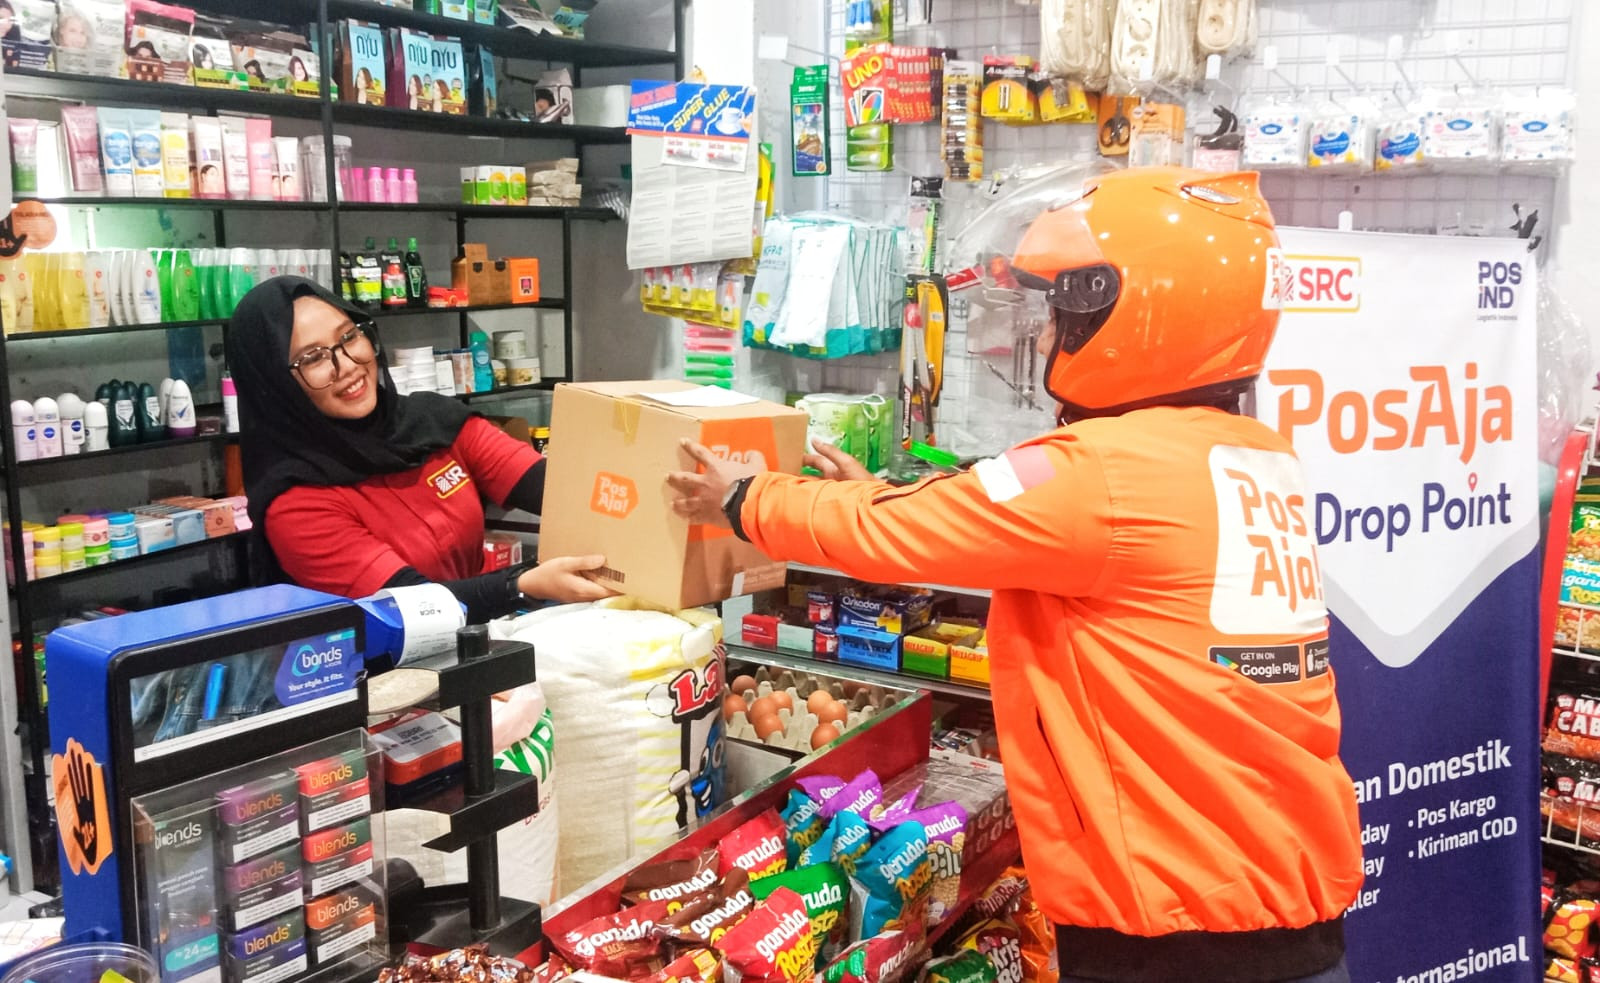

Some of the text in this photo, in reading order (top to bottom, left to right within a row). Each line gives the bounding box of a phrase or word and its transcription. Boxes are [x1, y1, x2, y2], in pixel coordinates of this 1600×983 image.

[847, 56, 883, 89] UNO
[673, 97, 704, 132] SUPER
[704, 87, 730, 119] GLUE
[1299, 267, 1353, 302] SRC
[1478, 261, 1522, 285] POS
[1268, 362, 1513, 465] PosAja
[600, 476, 627, 498] Pos
[598, 493, 629, 513] Aja!
[1223, 468, 1308, 537] Pos
[1315, 492, 1411, 552] Drop
[1422, 473, 1512, 532] Point
[1247, 535, 1324, 614] Aja!
[302, 646, 343, 669] bonds
[951, 649, 983, 664] MIXAGRIP
[1240, 652, 1255, 661] GET
[1240, 661, 1300, 678] Google Play
[310, 764, 353, 789] blends
[1354, 739, 1512, 805] an Domestik
[236, 792, 283, 821] blends
[1418, 796, 1497, 829] Pos Kargo
[924, 814, 963, 843] aruda
[1361, 823, 1390, 846] day
[1418, 816, 1518, 859] Kiriman COD
[314, 832, 357, 857] blends
[732, 835, 785, 871] aruda
[239, 860, 286, 888] blends
[880, 838, 927, 885] garuda
[317, 896, 359, 923] blends
[803, 882, 842, 910] ruda
[691, 889, 753, 940] garuda
[244, 926, 290, 955] blends
[756, 908, 809, 964] garuda
